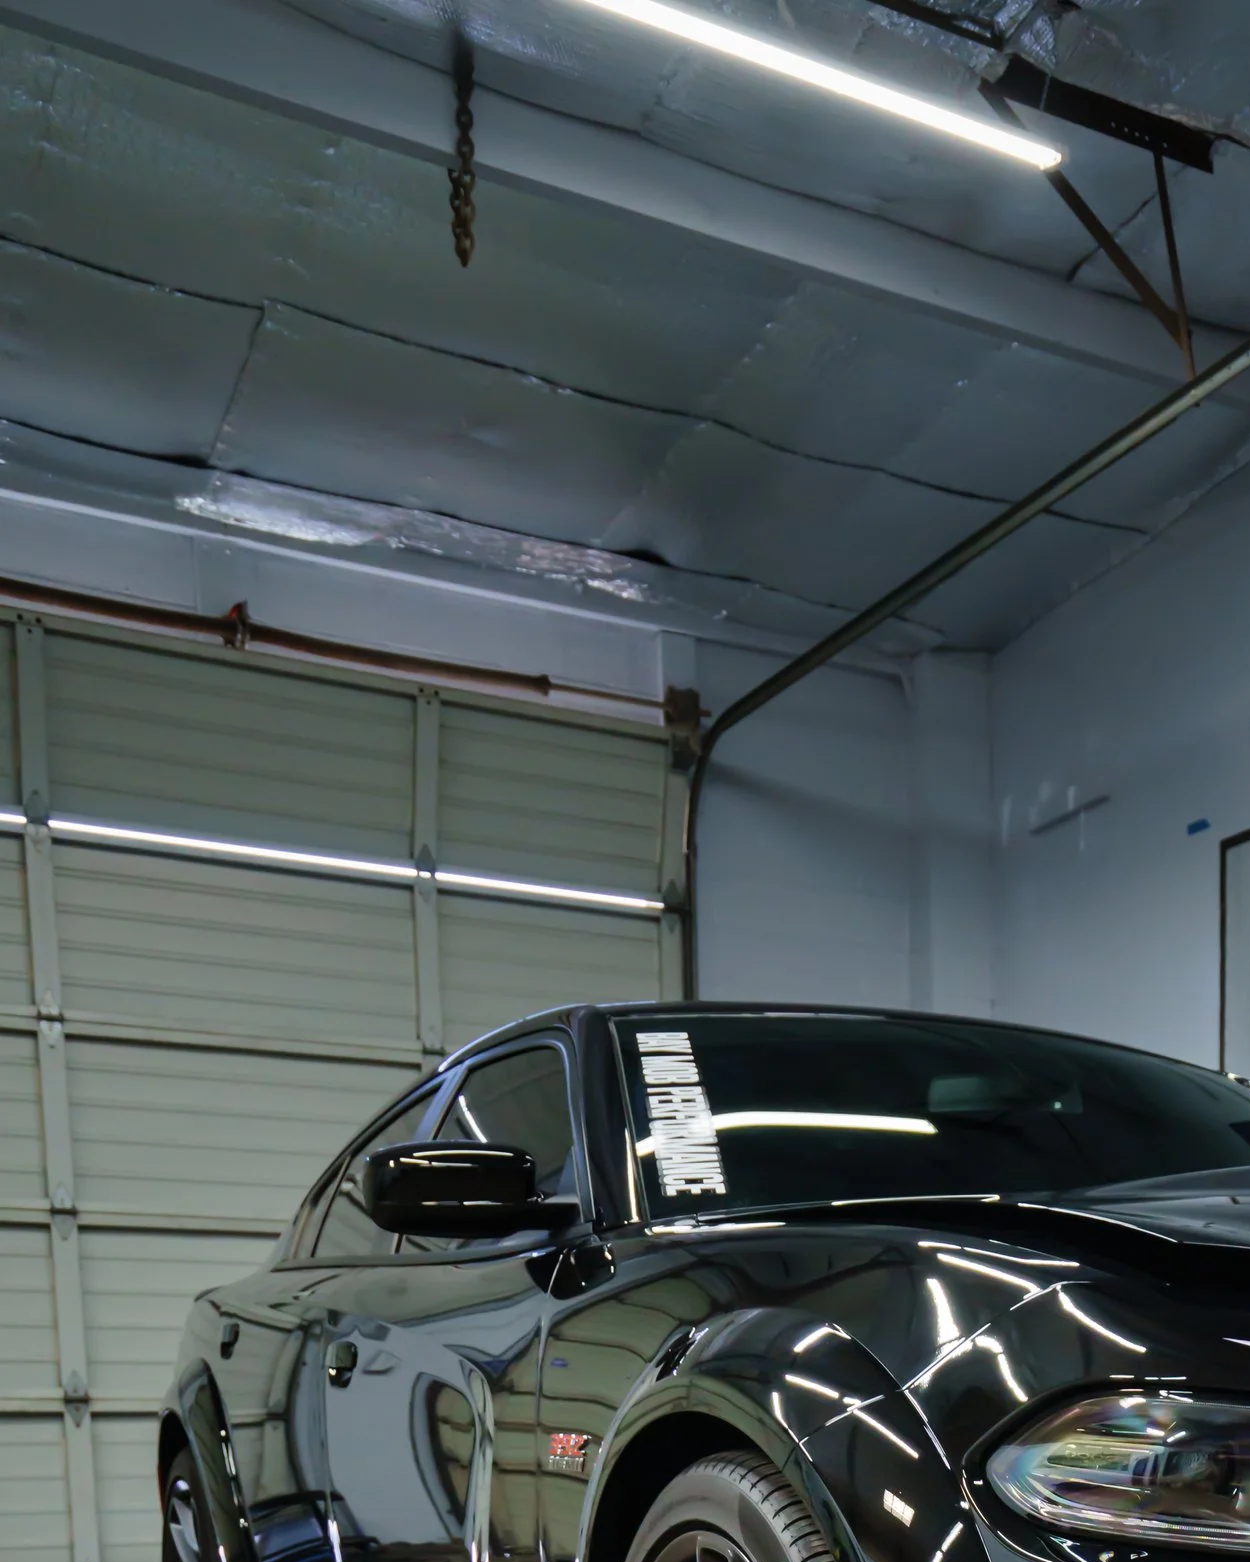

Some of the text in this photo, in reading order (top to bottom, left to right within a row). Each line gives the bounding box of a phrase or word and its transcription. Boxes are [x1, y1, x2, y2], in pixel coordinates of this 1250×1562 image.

[635, 1032, 727, 1197] BAY MOB PERFORMANCE
